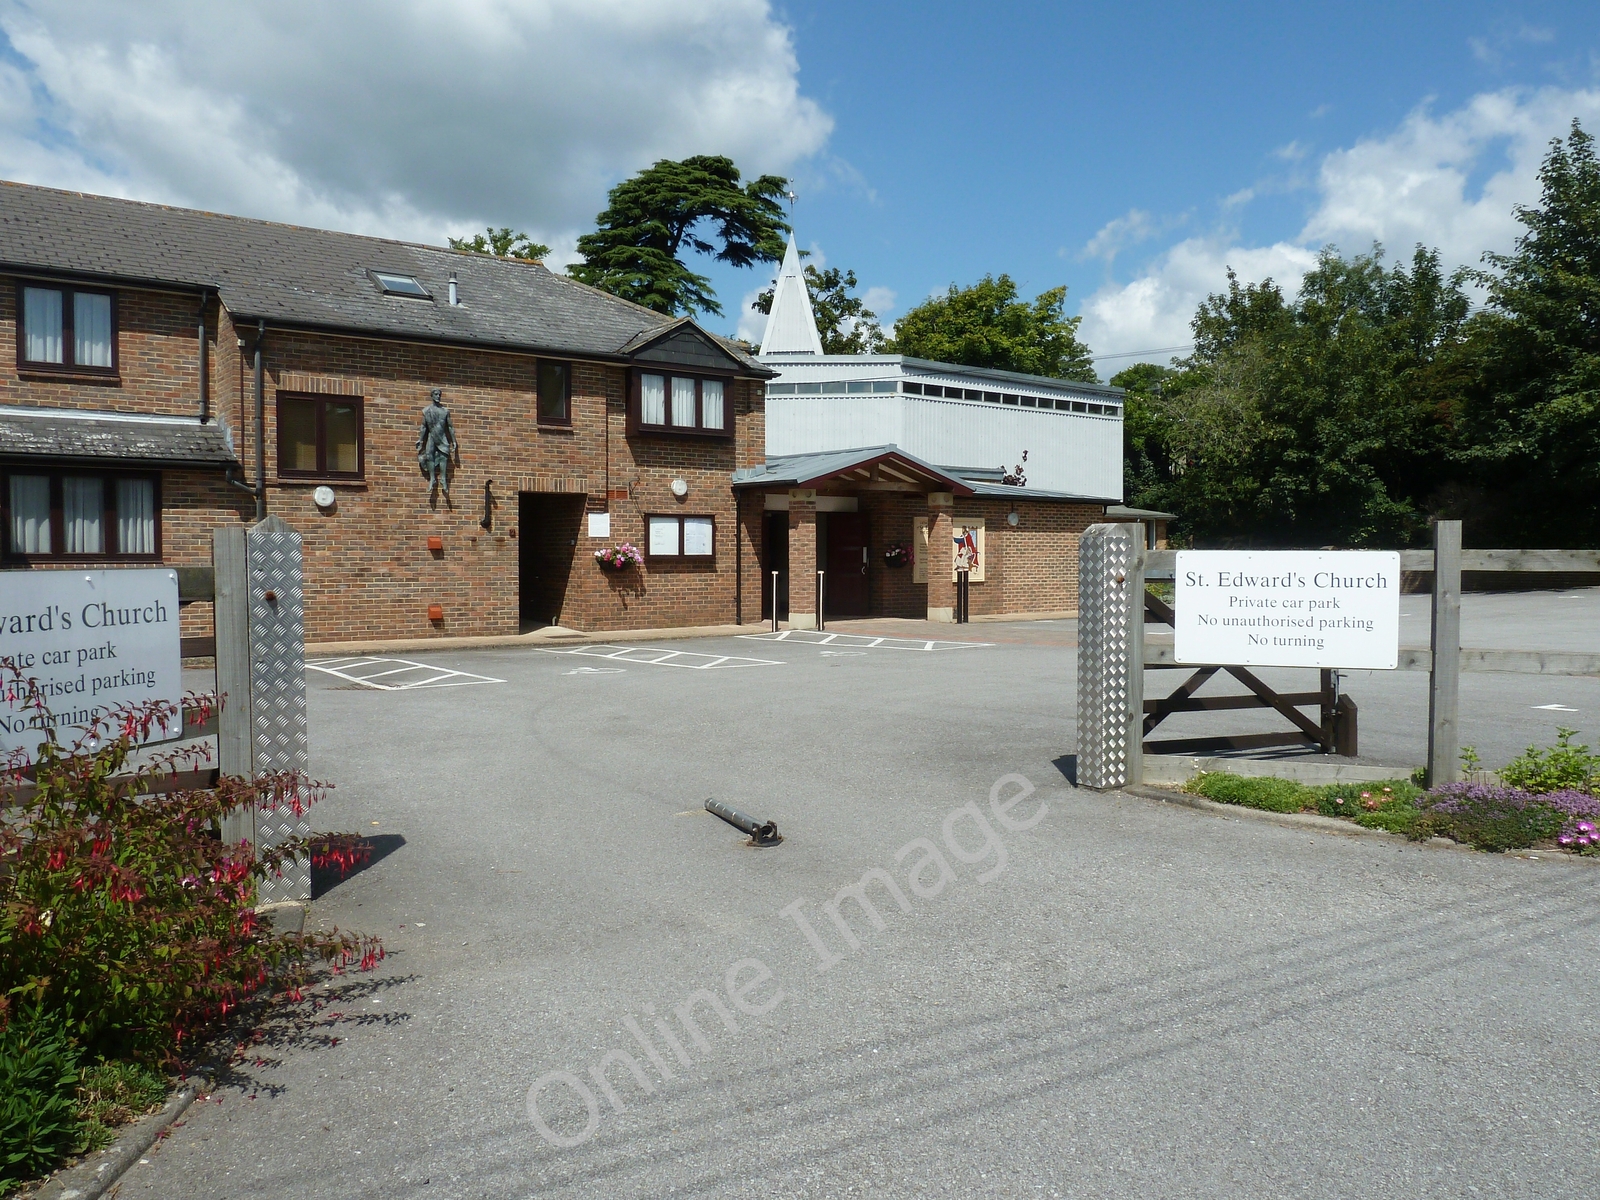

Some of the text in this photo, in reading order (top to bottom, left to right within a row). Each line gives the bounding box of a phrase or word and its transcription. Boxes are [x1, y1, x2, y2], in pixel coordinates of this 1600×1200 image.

[1185, 572, 1388, 589] St. Edward's Church
[1229, 596, 1341, 612] Private car park
[82, 600, 167, 628] Church
[1198, 614, 1374, 632] No unauthorised parking
[1248, 634, 1325, 650] No turning
[42, 649, 71, 665] car
[77, 641, 117, 667] park
[91, 669, 156, 696] parking
